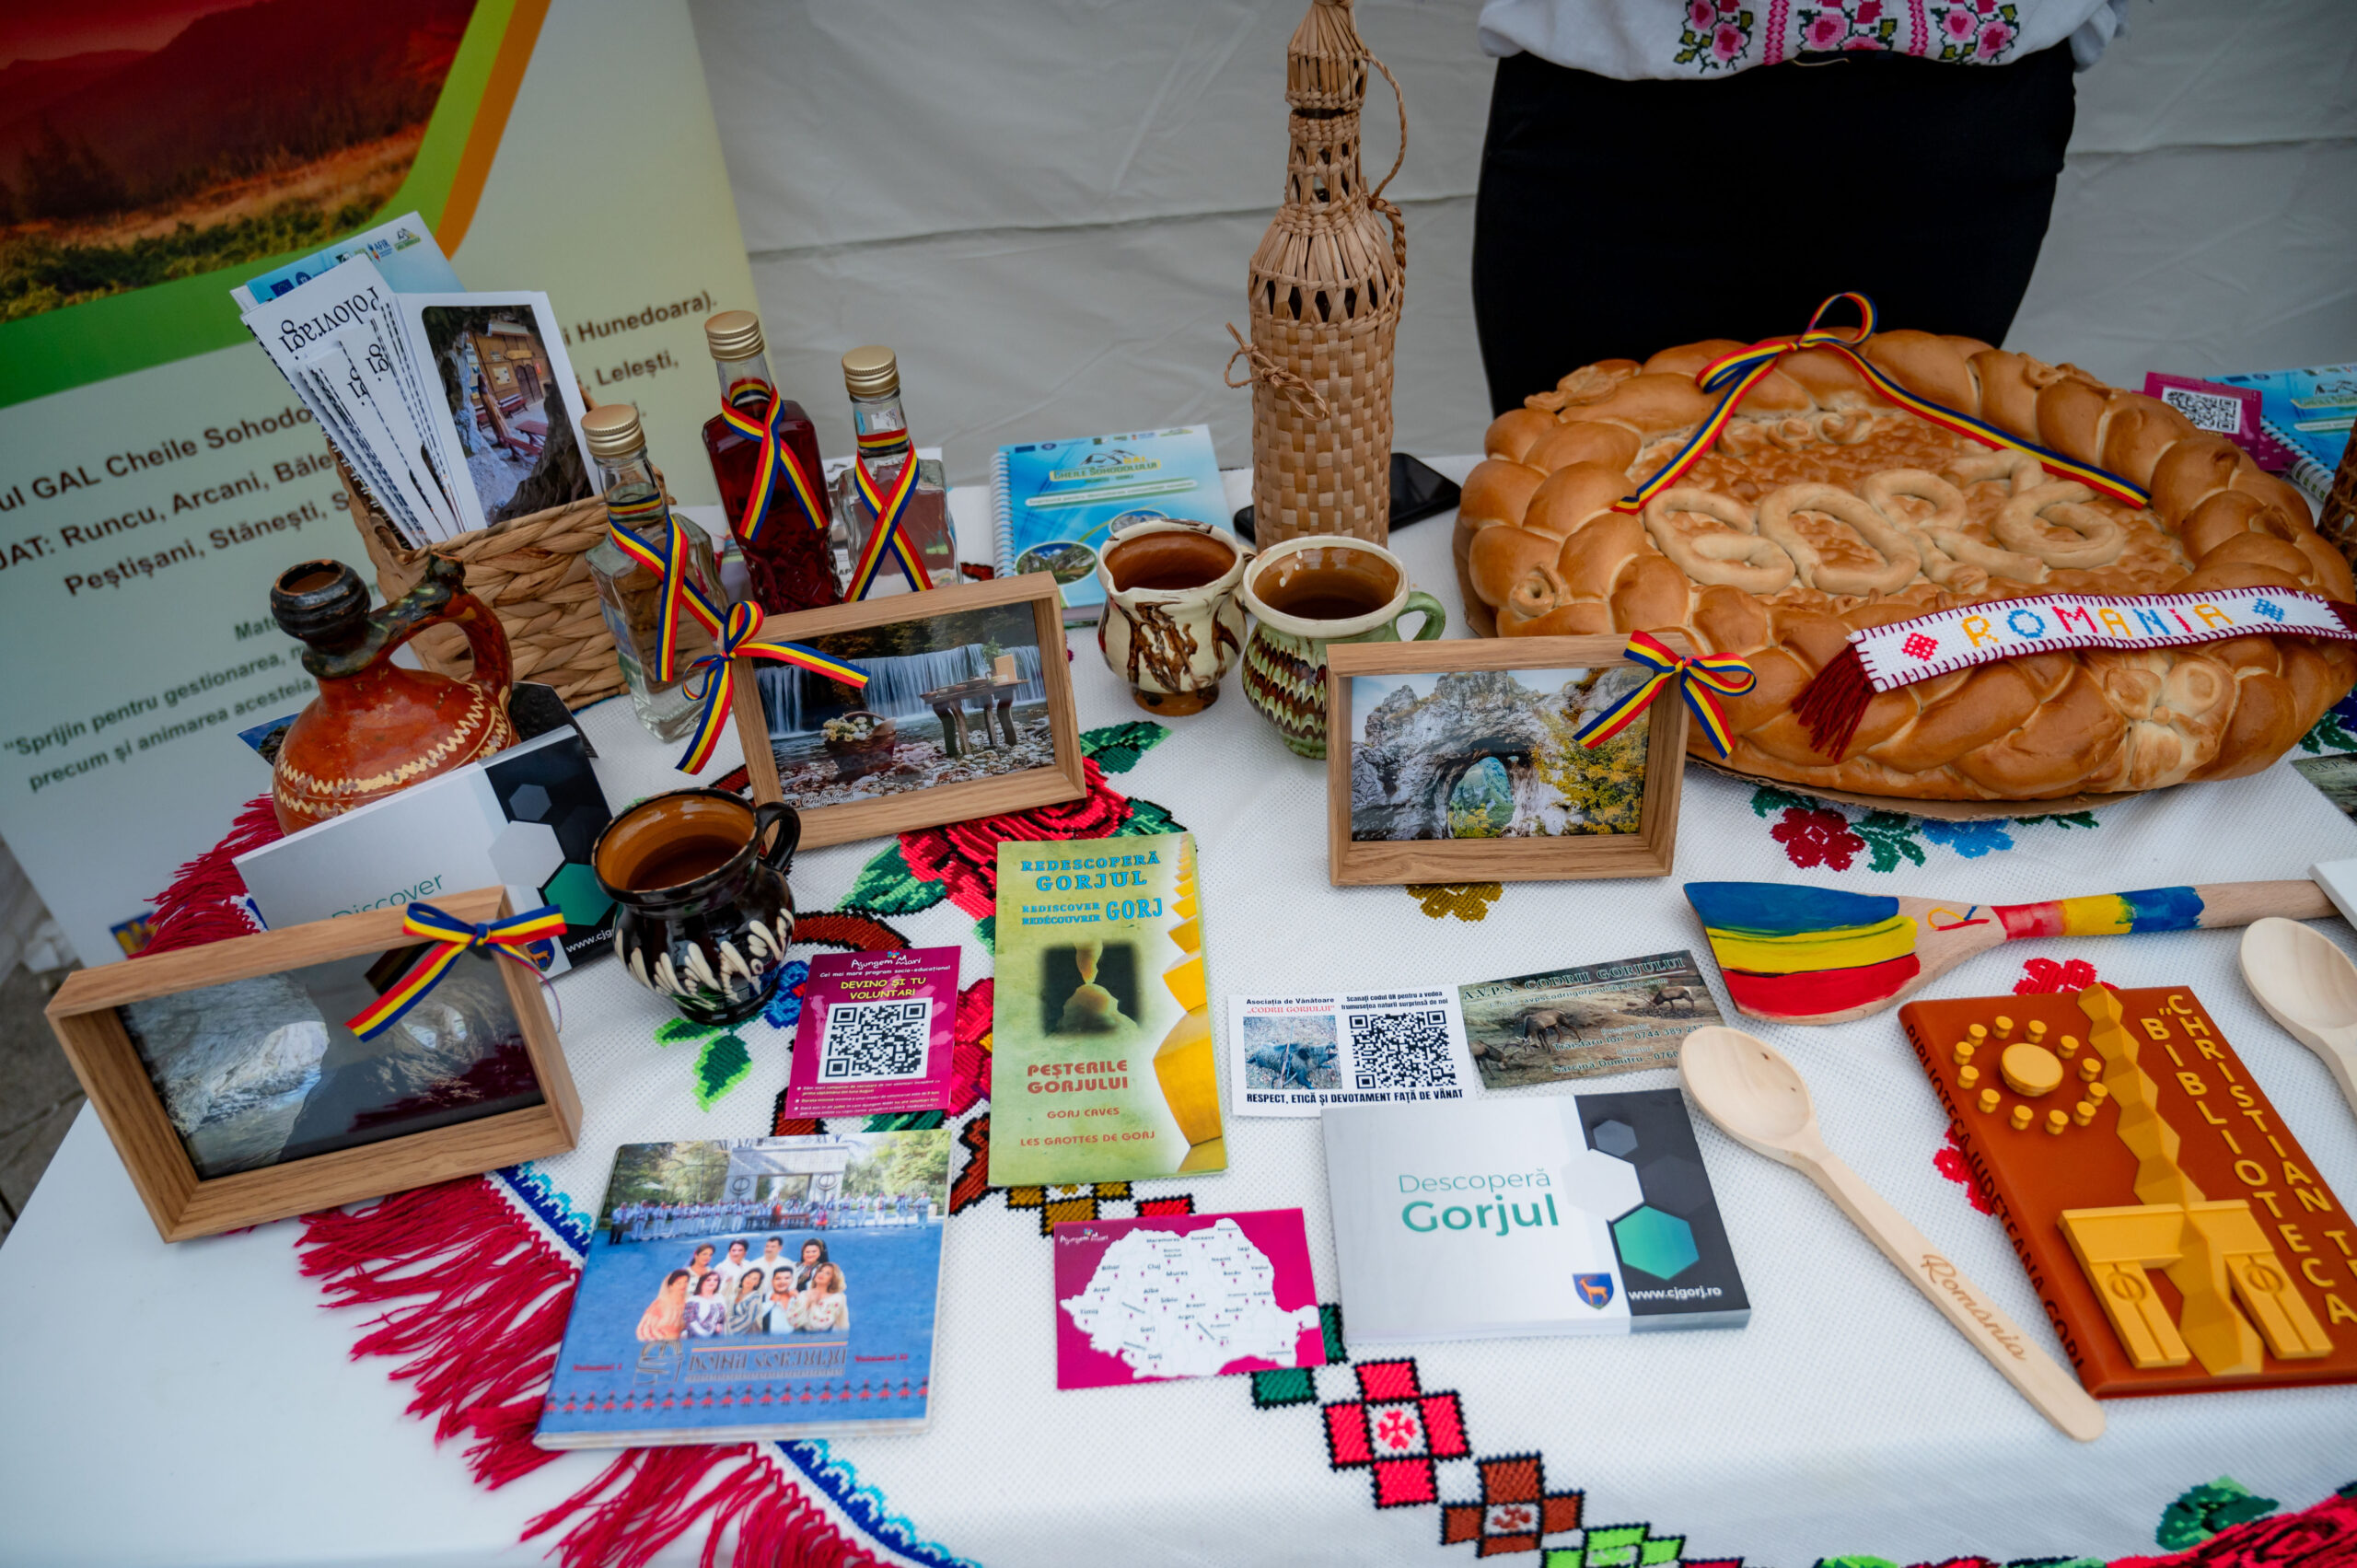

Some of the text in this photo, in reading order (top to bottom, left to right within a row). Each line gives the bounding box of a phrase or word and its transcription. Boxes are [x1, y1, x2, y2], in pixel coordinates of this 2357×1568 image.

[32, 467, 101, 499] GAL
[105, 438, 198, 478] Cheile
[203, 406, 313, 450] Sohodo
[576, 290, 717, 343] Hunedoara).
[60, 505, 167, 548] Runcu,
[171, 470, 271, 515] Arcani,
[272, 452, 334, 485] Băle
[64, 539, 206, 597] Peștișani,
[1960, 603, 2234, 647] ROMANIA
[91, 696, 158, 734] pentru
[164, 653, 285, 708] gestionarea,
[29, 751, 109, 793] precum
[114, 738, 133, 764] și
[138, 707, 228, 750] animarea
[1021, 851, 1161, 872] REDESCOPERĂ
[1036, 870, 1147, 891] GORJUL
[1022, 898, 1163, 921] REDISCOVER GORJ
[565, 928, 613, 953] www.cjg
[851, 958, 893, 970] Ajungem
[865, 969, 892, 977] program
[840, 979, 888, 990] DEVINO
[1463, 957, 1686, 1001] A.V.P.S. CODRII GORJULUI
[850, 988, 916, 1000] VOLUNTARI
[1247, 998, 1282, 1006] Asociația
[1398, 992, 1417, 1001] pentru
[1634, 1029, 1660, 1040] 0744
[1028, 1060, 1128, 1079] PEȘTERILE
[1027, 1076, 1129, 1094] GORJULUI
[1247, 1093, 1289, 1104] RESPECT,
[1291, 1091, 1317, 1103] ETICĂ
[1330, 1092, 1390, 1103] DEVOTAMENT
[1420, 1091, 1431, 1100] DE
[1434, 1088, 1463, 1100] VÂNAT
[1047, 1107, 1120, 1119] GORJ CAVES
[1020, 1131, 1155, 1147] LES GROTTES DE GORJ
[1398, 1167, 1551, 1193] Descoperă
[1400, 1193, 1560, 1237] Gorjul
[1627, 1285, 1724, 1303] www.cjgorj.ro
